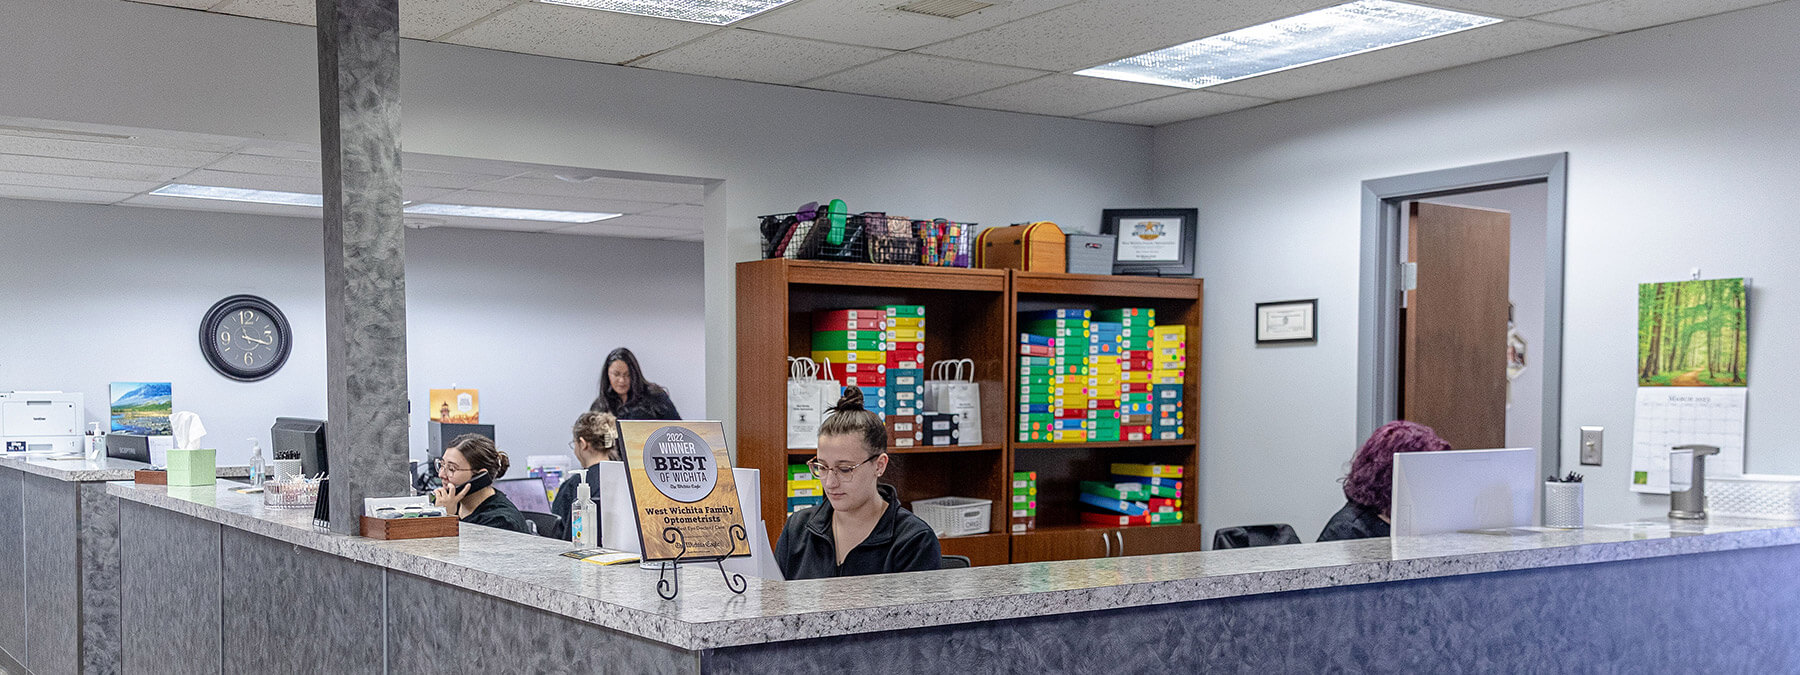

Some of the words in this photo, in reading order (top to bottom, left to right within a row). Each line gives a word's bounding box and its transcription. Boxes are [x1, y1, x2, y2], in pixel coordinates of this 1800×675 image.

[238, 310, 254, 324] 12
[221, 332, 230, 345] 9
[264, 331, 272, 345] 3
[244, 352, 253, 366] 6
[666, 433, 684, 441] 2022
[659, 442, 696, 454] WINNER
[652, 456, 707, 471] BEST
[660, 473, 670, 482] OF
[672, 472, 707, 482] WICHITA
[645, 507, 668, 515] West
[670, 506, 703, 514] Wichita
[705, 506, 734, 515] Family
[664, 515, 720, 525] Optometrists
